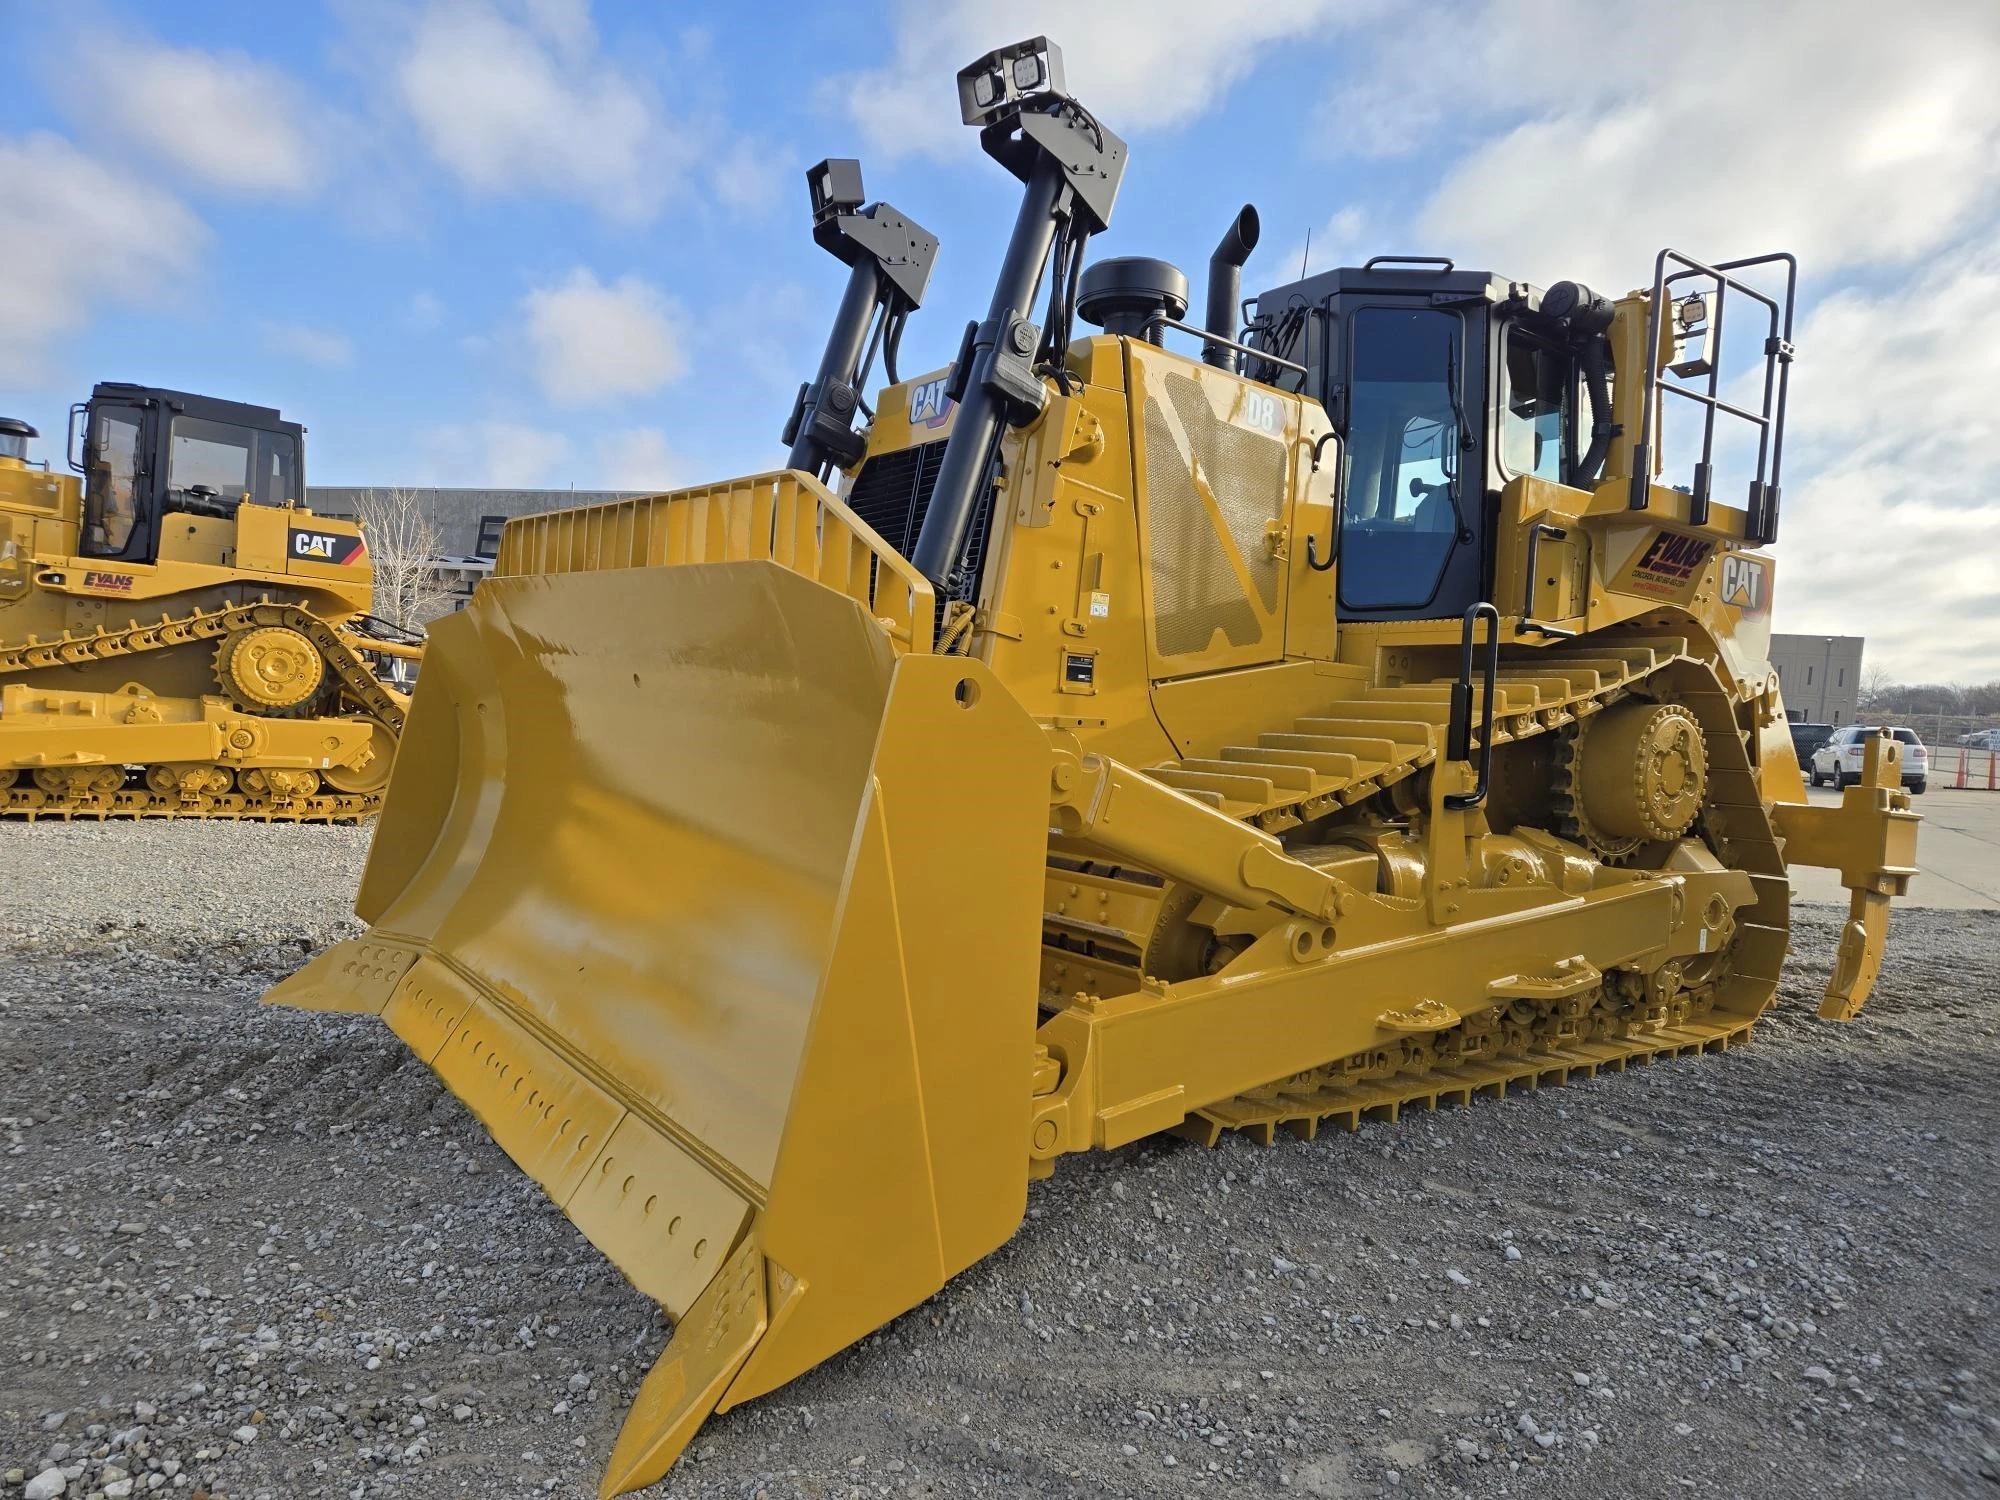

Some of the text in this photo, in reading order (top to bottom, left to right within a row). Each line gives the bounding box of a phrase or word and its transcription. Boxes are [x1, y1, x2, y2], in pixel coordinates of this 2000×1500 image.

[911, 378, 948, 423] CAT
[1248, 390, 1274, 432] D8
[295, 533, 336, 558] CAT
[1637, 530, 1713, 570] EVANS
[83, 571, 134, 587] EVANS
[1722, 555, 1762, 609] CAT
